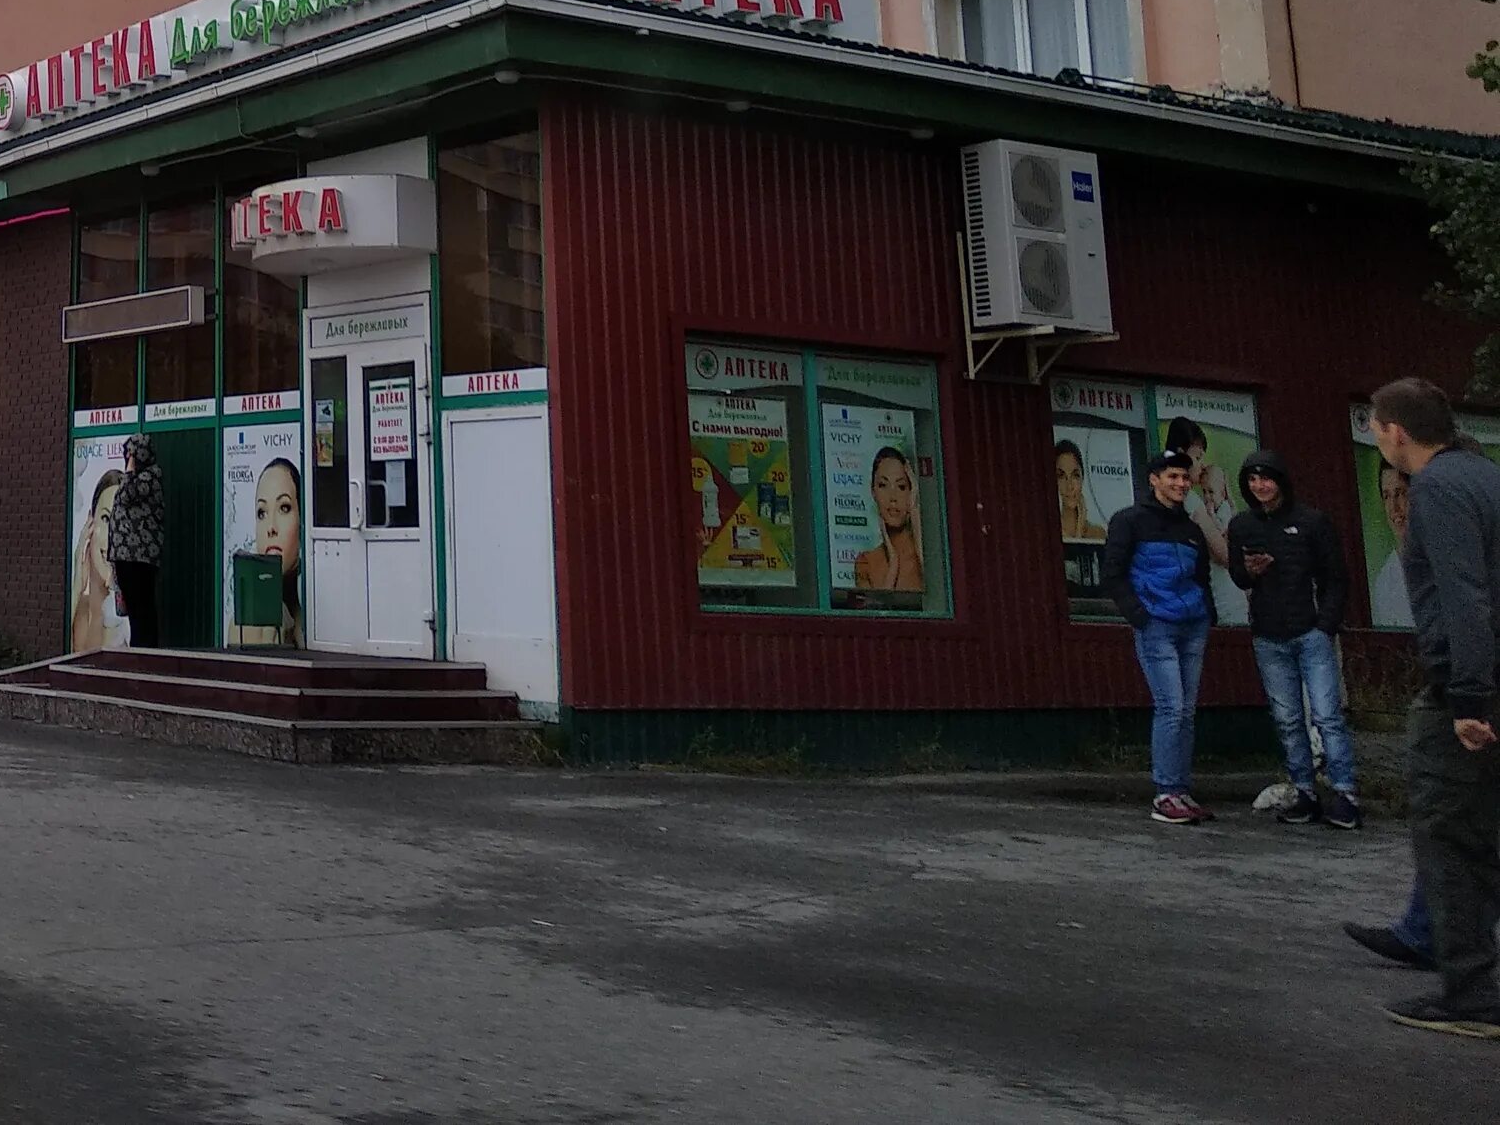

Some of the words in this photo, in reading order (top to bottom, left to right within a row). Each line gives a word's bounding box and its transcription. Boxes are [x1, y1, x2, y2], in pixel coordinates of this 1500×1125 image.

[26, 19, 157, 119] АПТЕКА
[170, 17, 219, 68] Для
[231, 187, 343, 249] ТЕКА
[325, 321, 345, 339] Для
[348, 317, 408, 338] бережливых
[725, 357, 789, 381] АПТЕКА
[468, 373, 520, 393] АПТЕКА
[241, 394, 282, 411] АПТЕКА
[1078, 388, 1133, 411] АПТЕКА
[89, 409, 122, 424] АПТЕКА
[702, 423, 731, 434] нами
[733, 426, 783, 437] выгодно!
[831, 433, 862, 444] VICHY
[263, 434, 293, 447] VICHY
[1091, 464, 1130, 476] FILORGA
